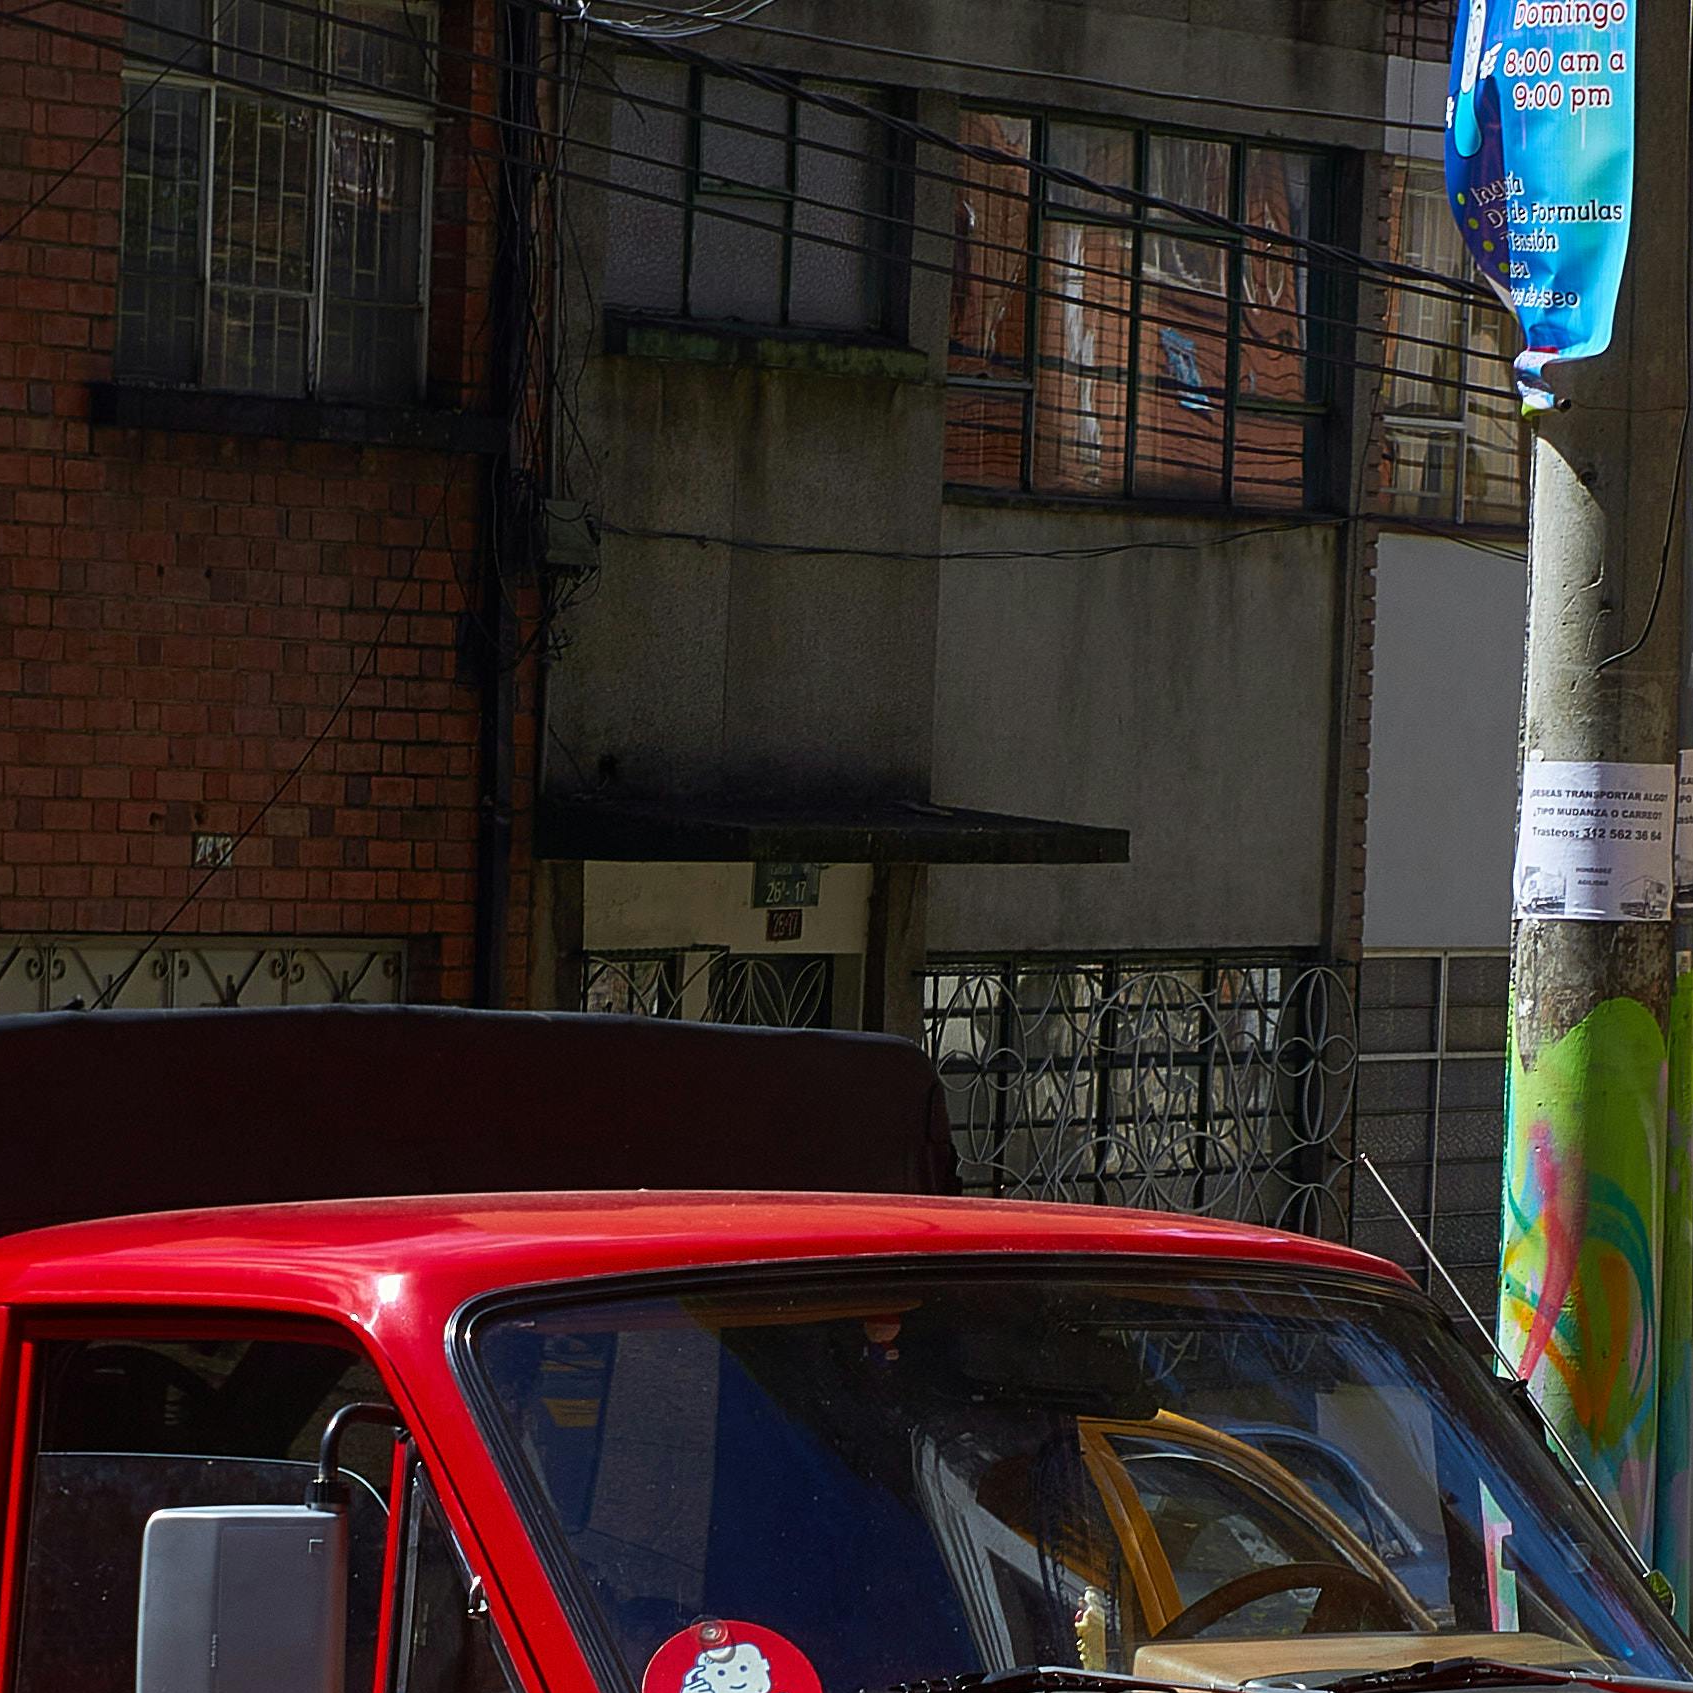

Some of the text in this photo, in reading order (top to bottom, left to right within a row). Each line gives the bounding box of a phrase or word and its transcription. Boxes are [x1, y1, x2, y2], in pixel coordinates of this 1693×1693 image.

[1514, 0, 1626, 29] Domingo
[1505, 50, 1625, 74] 8:00 am a
[1514, 83, 1610, 112] 9:00 pm
[1530, 200, 1623, 223] Formulas
[1565, 789, 1642, 801] TRANSPORTAR
[1556, 808, 1608, 818] MUDANZA
[1611, 809, 1619, 818] O
[1532, 826, 1580, 838] Trasteos:
[1583, 827, 1606, 839] 312
